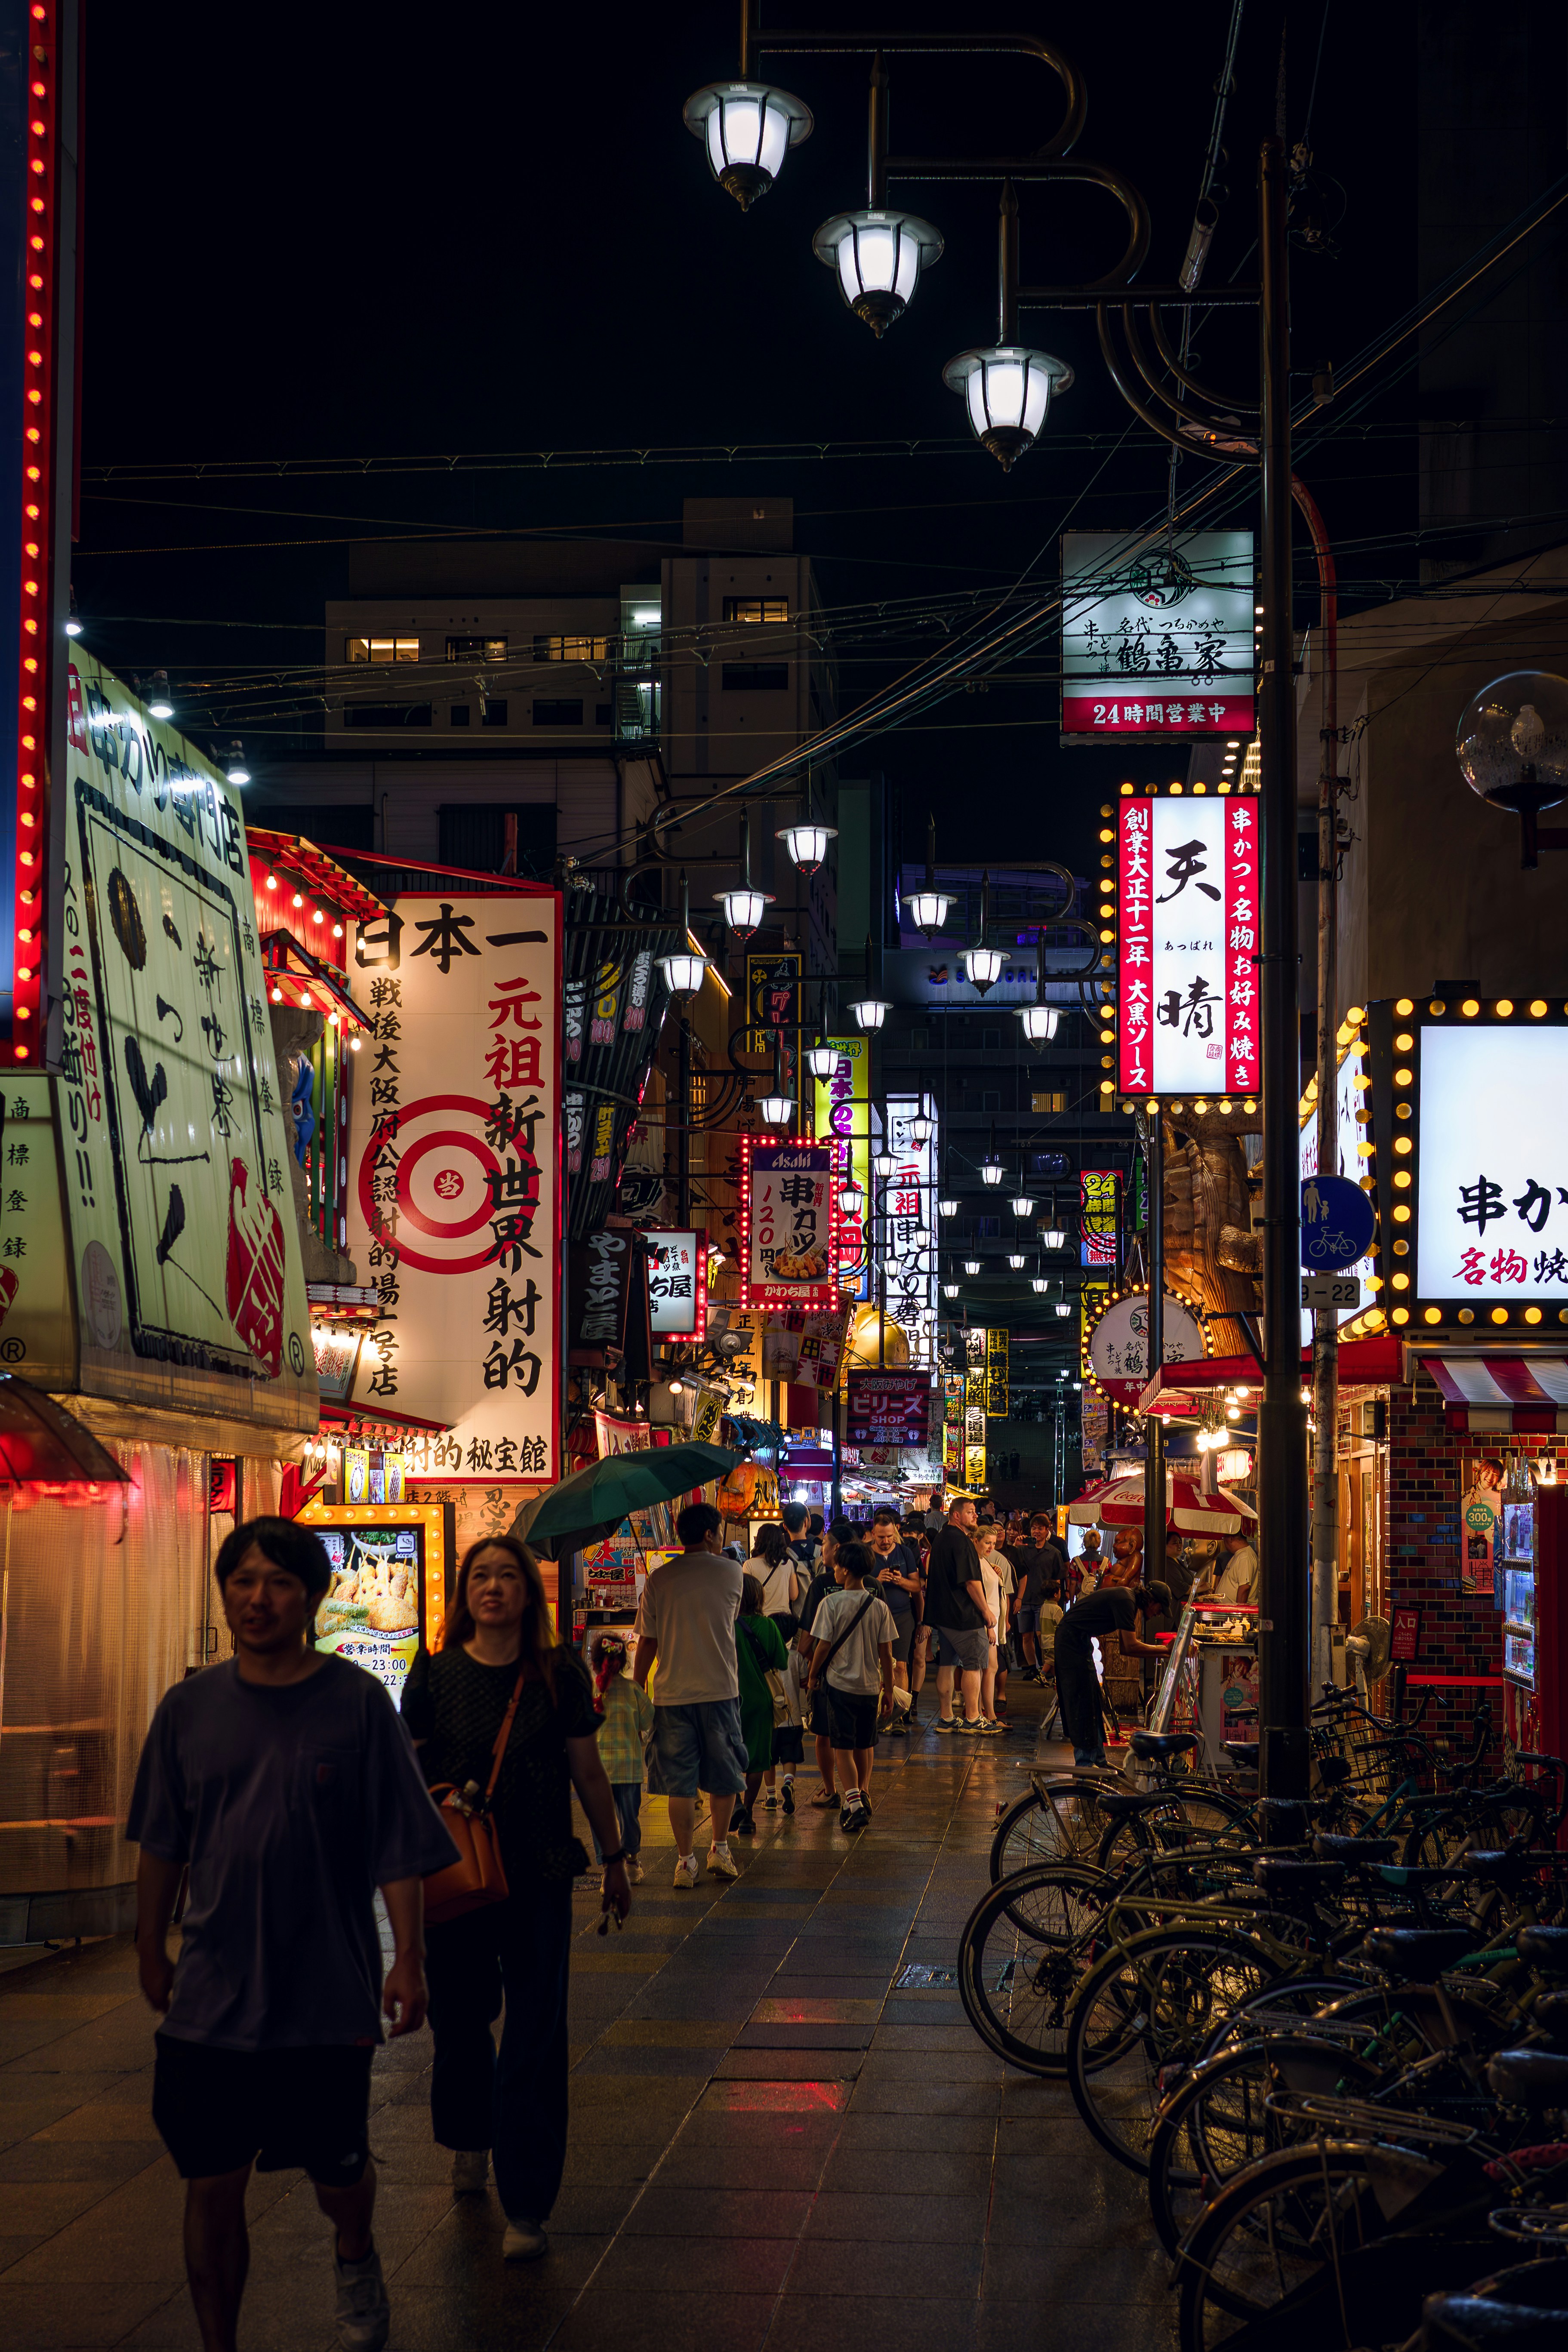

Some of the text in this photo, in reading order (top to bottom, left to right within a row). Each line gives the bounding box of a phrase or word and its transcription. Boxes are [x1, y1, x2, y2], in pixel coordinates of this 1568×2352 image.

[1117, 617, 1153, 634] 名代
[1083, 619, 1100, 661] 串かつ
[1094, 703, 1226, 724] 24時間営業中
[355, 903, 549, 974] 日本一
[1124, 807, 1150, 1088] 創業大正十二年 大黒ソース
[1229, 807, 1256, 1087] 串かつ・名物お好み焼き
[590, 1157, 610, 1182] 250
[772, 1152, 811, 1168] Asahi
[1, 1096, 31, 1259] 商標登録
[1084, 1173, 1115, 1197] 24
[813, 1182, 825, 1207] 新世界
[779, 1173, 816, 1256] 串カツ
[580, 1232, 626, 1340] やまと屋
[764, 1285, 810, 1297] かわち屋
[860, 1378, 917, 1391] 大阪みやげ
[853, 1394, 922, 1414] ビリーズ
[871, 1416, 905, 1424] SHOP
[1395, 1616, 1416, 1629] 入口
[344, 1644, 391, 1655] 営業時間
